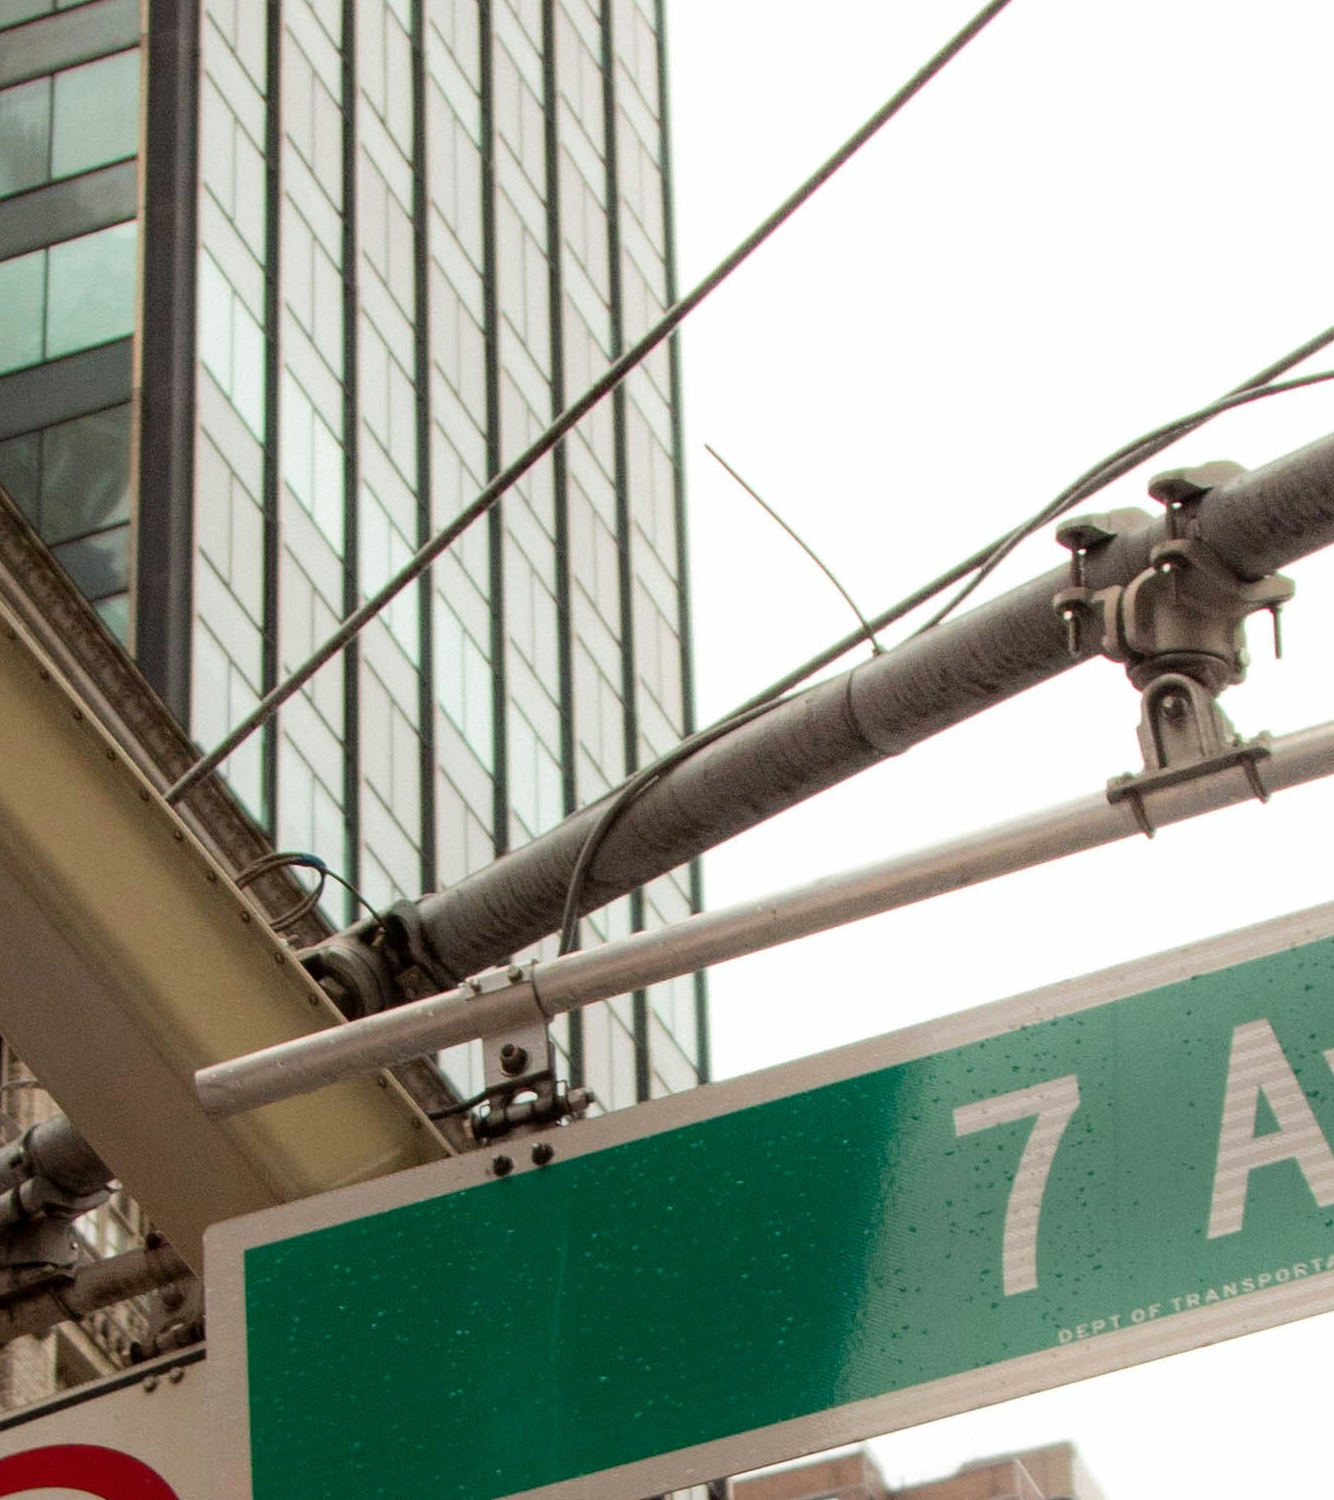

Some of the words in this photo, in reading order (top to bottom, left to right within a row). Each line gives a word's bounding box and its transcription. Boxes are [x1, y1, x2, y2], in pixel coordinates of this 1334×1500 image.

[953, 1074, 1080, 1296] 7
[1058, 1315, 1121, 1344] DEPT
[1131, 1302, 1162, 1324] OF
